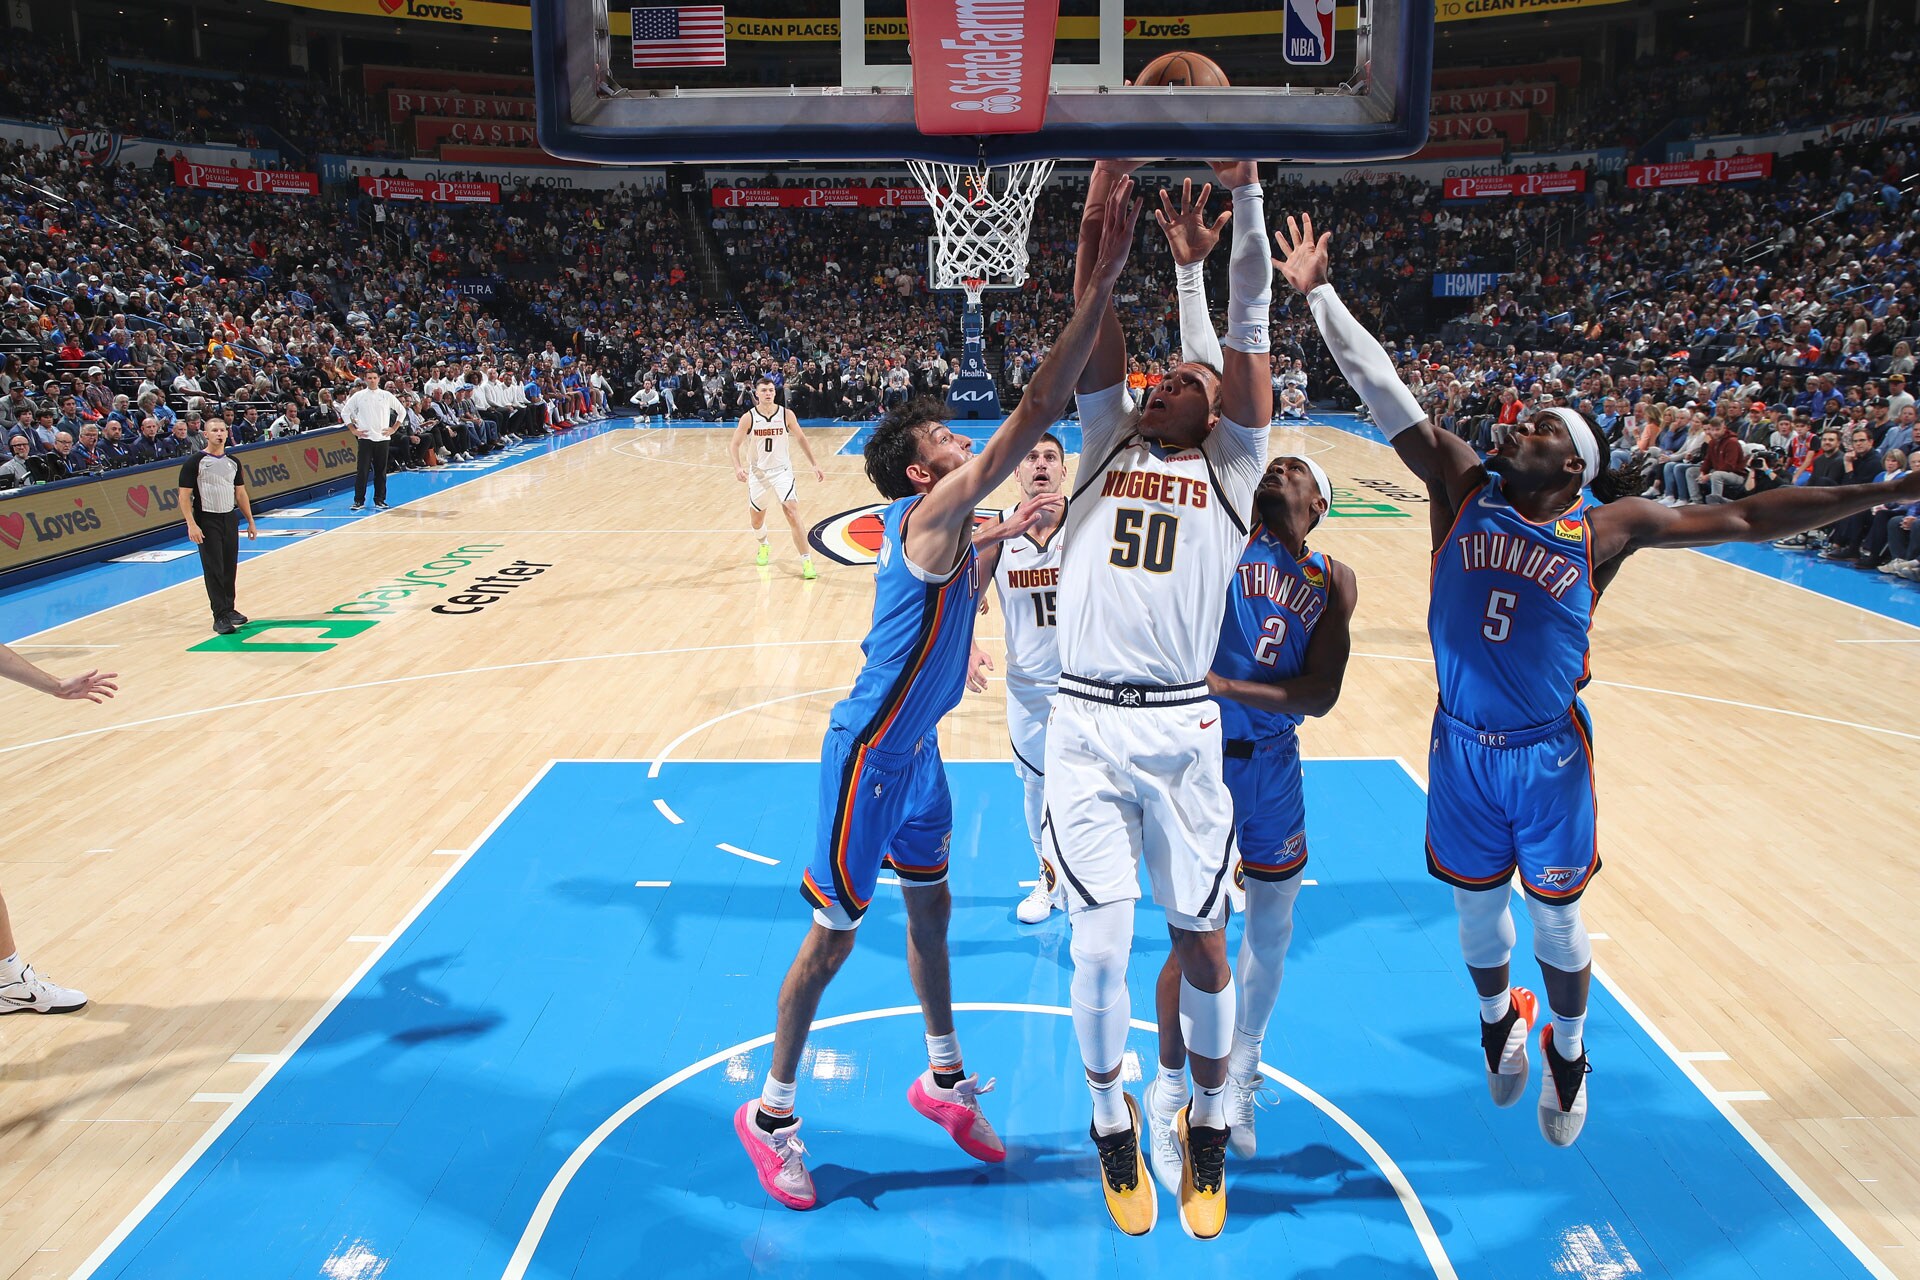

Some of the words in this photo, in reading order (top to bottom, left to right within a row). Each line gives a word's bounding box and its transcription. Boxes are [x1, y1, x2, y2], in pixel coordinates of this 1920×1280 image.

[1465, 0, 1515, 13] CLEAN
[737, 22, 783, 36] CLEAN
[787, 24, 841, 39] PLACES,
[1290, 38, 1315, 57] NBA
[205, 167, 230, 175] PARRISH
[206, 174, 239, 183] DEVAUGHN
[389, 180, 414, 188] PARRISH
[389, 186, 424, 195] DEVAUGHN
[961, 369, 985, 377] Health
[952, 391, 994, 401] KIA
[753, 428, 784, 436] NUGGETS
[764, 438, 773, 452] 0
[1165, 454, 1201, 464] ibotta
[1100, 470, 1208, 510] NUGGETS
[1109, 508, 1179, 574] 50
[1458, 531, 1584, 602] THUNDER
[324, 543, 505, 615] paycom
[431, 559, 553, 616] center
[1481, 588, 1519, 644] 5
[1253, 614, 1288, 668] 2
[1479, 733, 1506, 746] OKC
[1545, 871, 1571, 883] OKC
